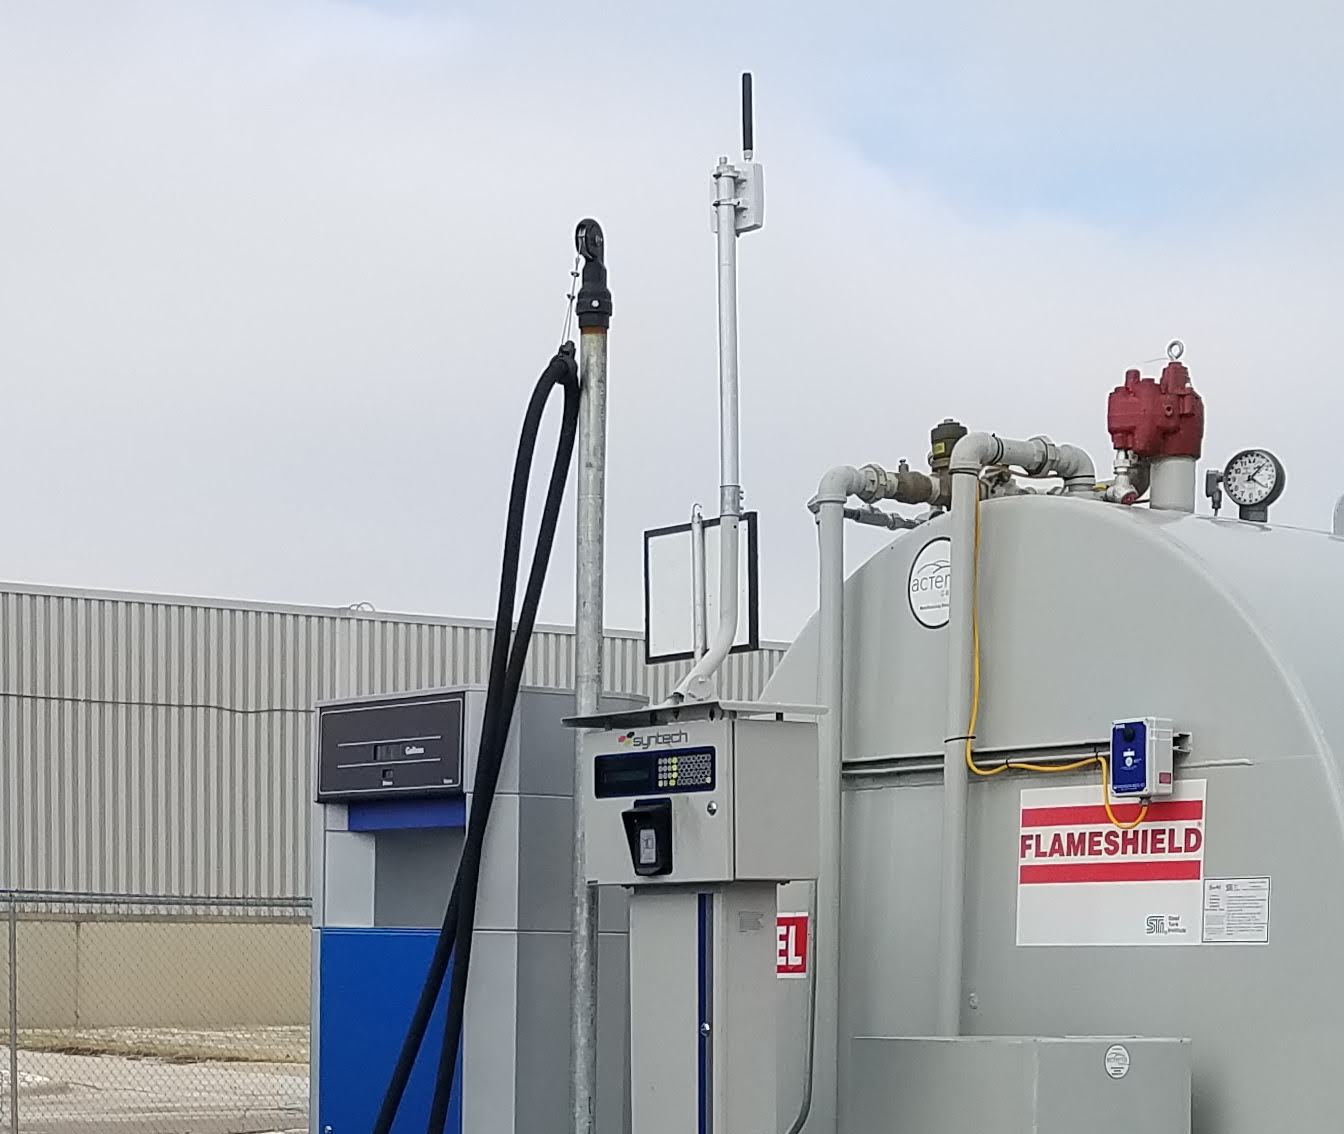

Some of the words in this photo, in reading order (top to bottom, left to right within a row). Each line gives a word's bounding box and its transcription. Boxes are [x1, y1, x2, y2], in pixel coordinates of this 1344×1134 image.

[633, 730, 689, 750] syntech
[1020, 827, 1203, 858] FLAMESHIELD
[776, 925, 803, 966] EL
